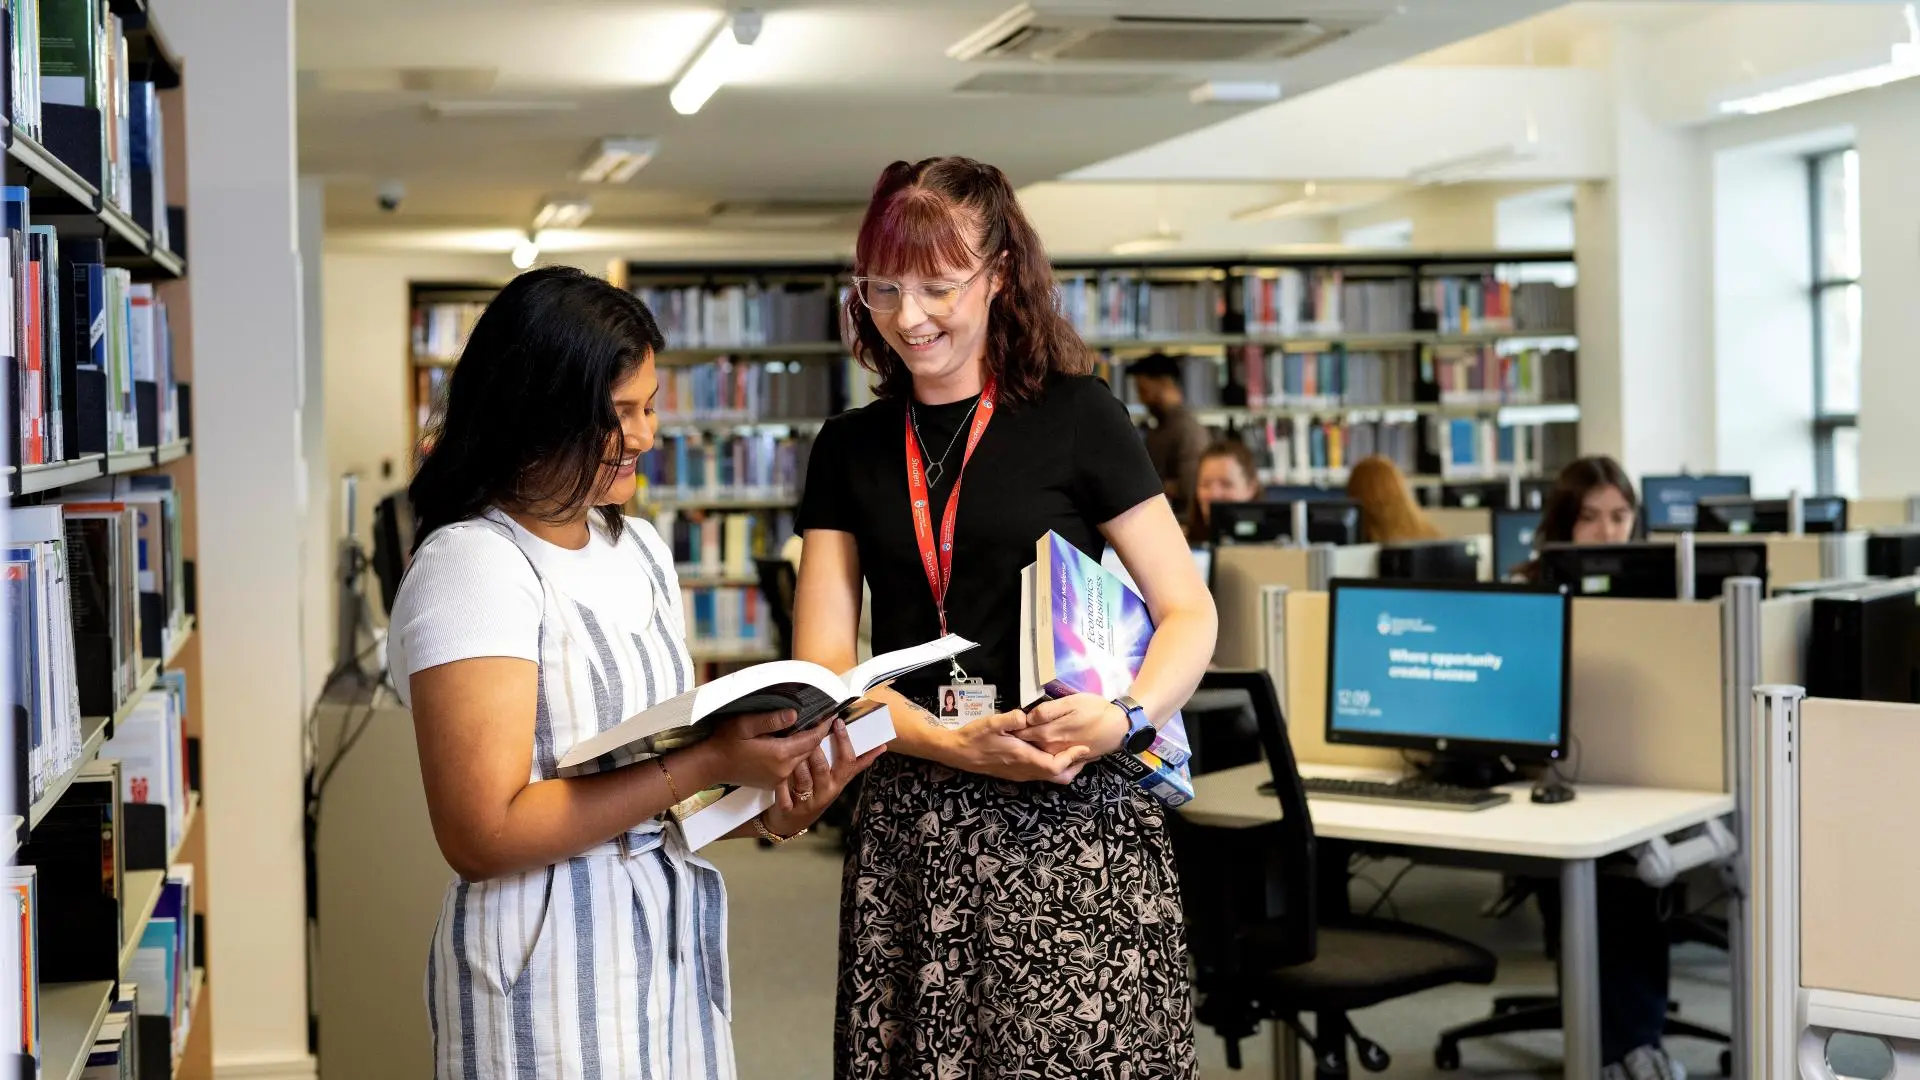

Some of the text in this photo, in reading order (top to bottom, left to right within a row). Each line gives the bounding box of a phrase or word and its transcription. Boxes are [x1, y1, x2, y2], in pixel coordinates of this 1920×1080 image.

[911, 457, 921, 488] Student
[925, 551, 937, 585] Student
[1087, 577, 1096, 644] Economics
[1096, 575, 1105, 650] for Business
[1389, 648, 1503, 671] Where opportunity
[1111, 751, 1144, 773] AINED
